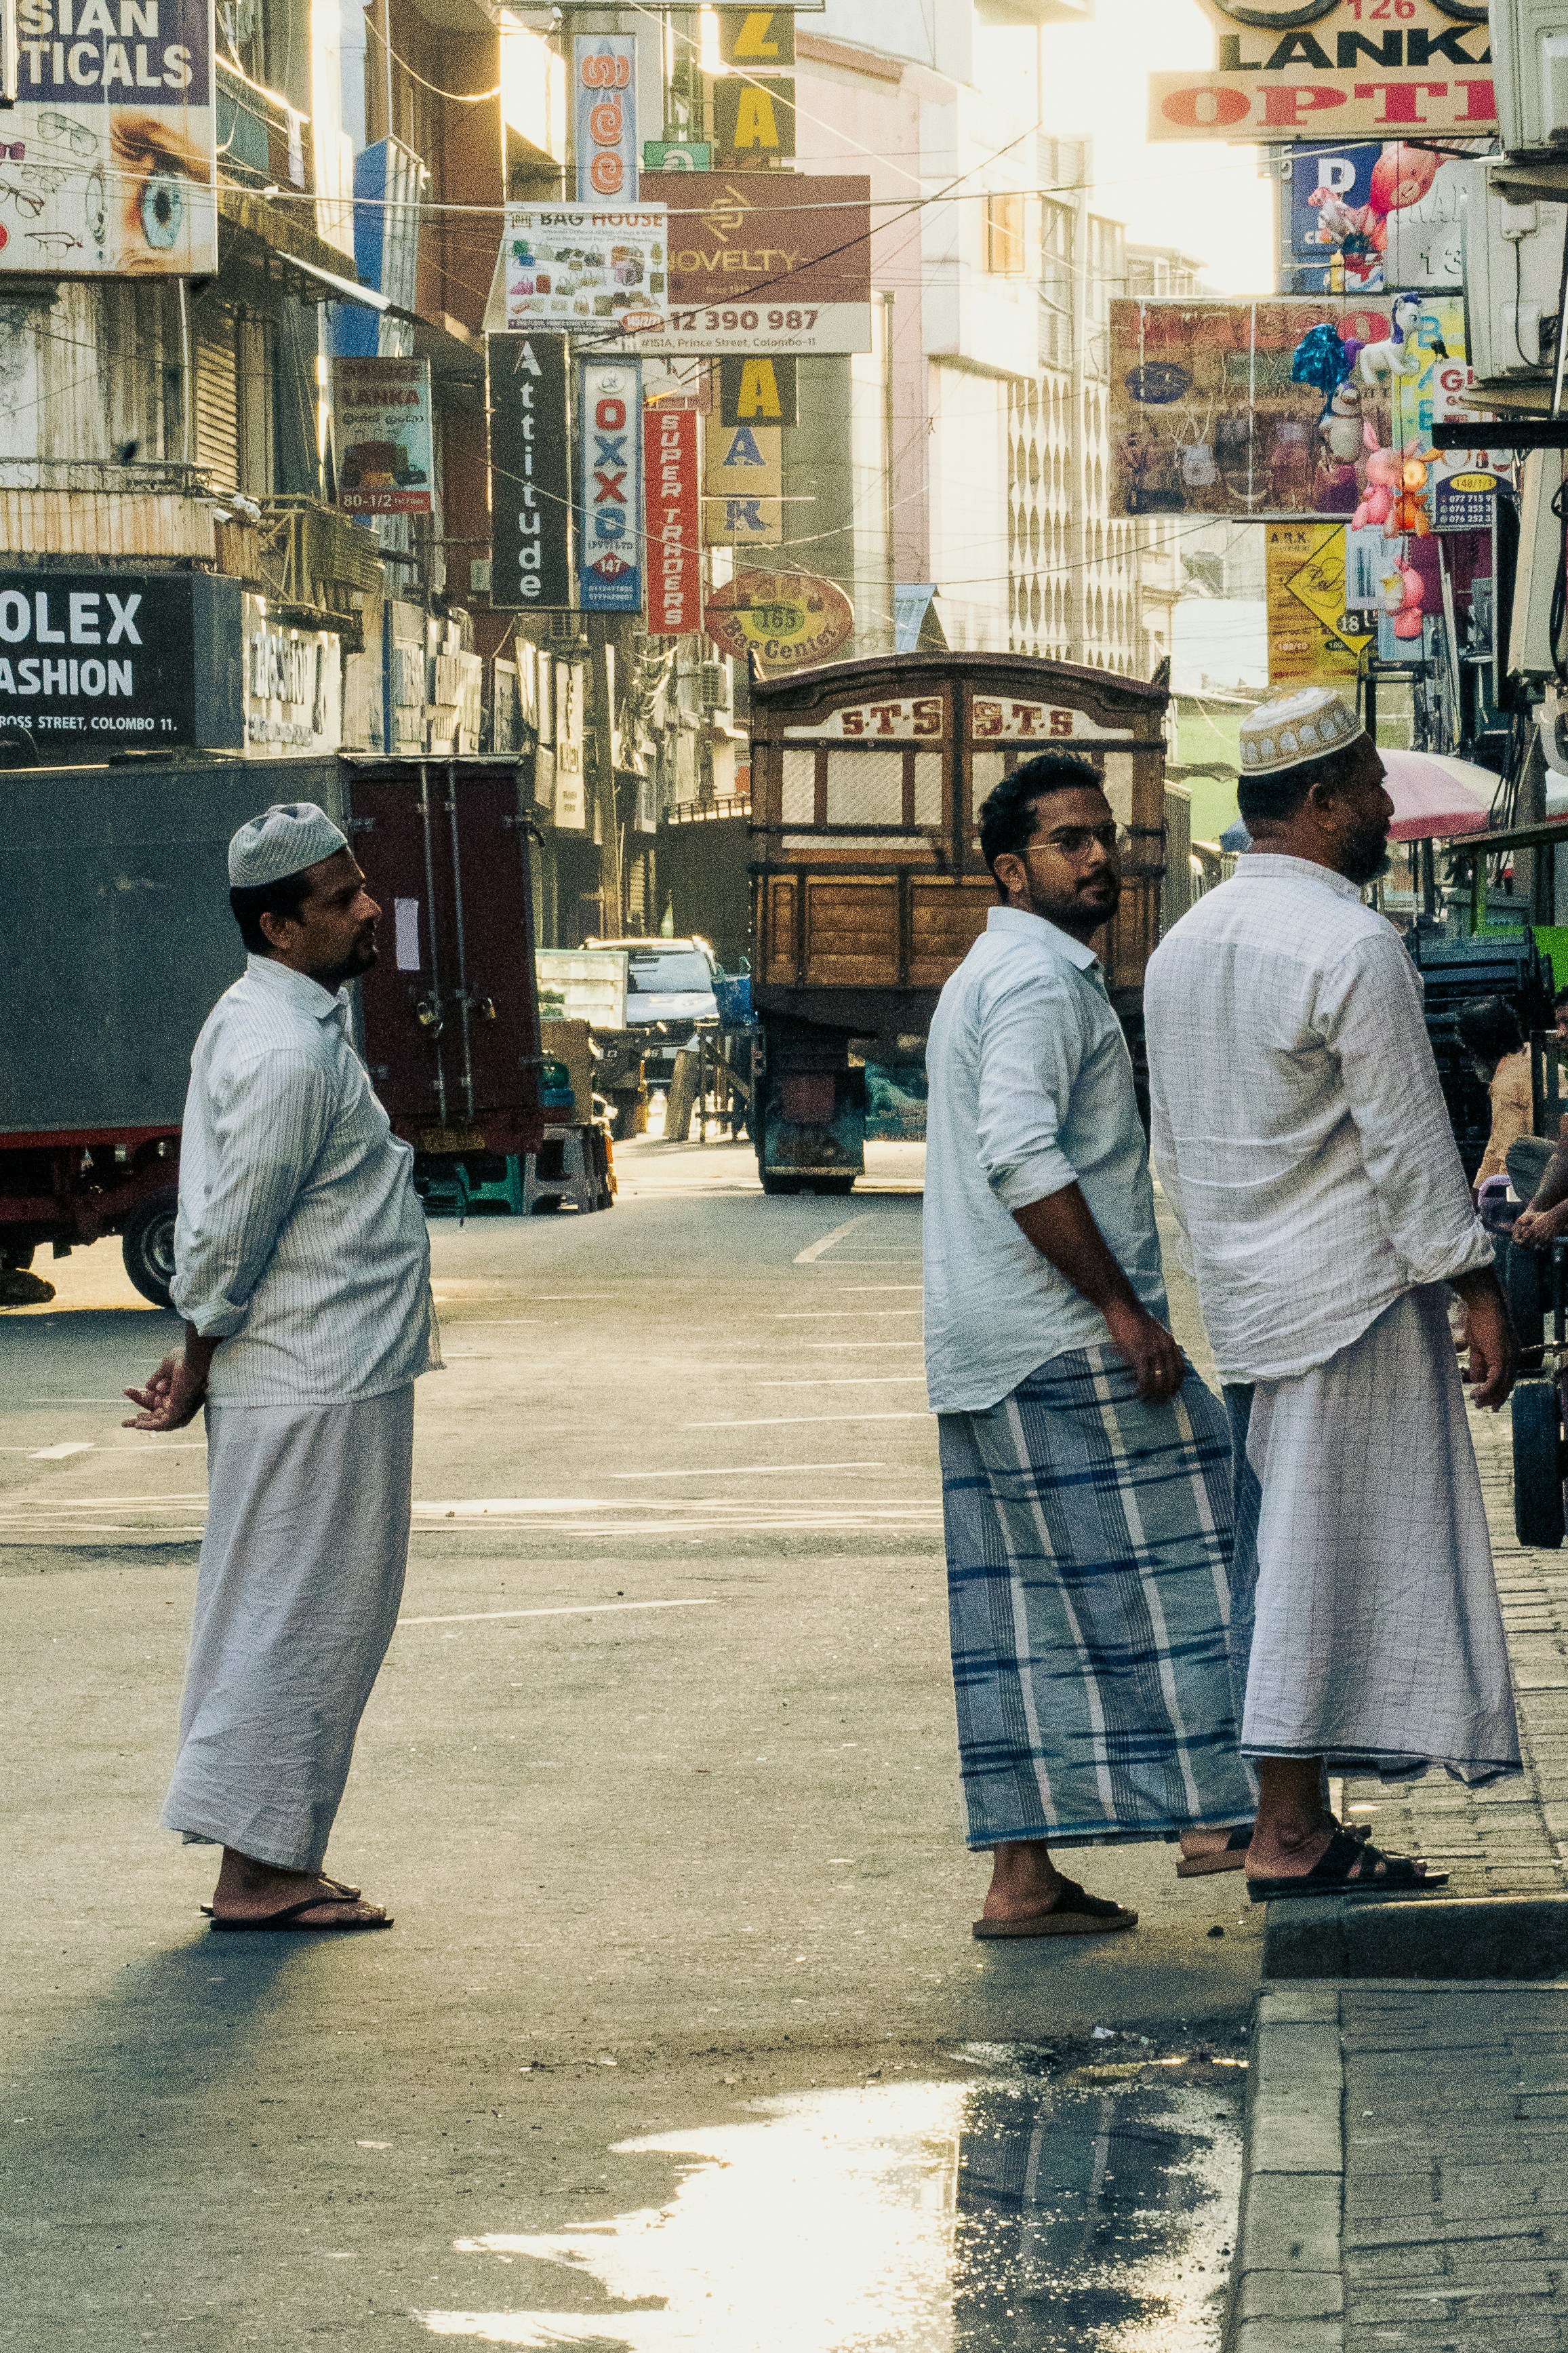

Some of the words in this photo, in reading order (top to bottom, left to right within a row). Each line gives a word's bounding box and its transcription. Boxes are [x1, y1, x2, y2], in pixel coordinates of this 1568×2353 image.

[1345, 0, 1416, 21] 126
[1220, 25, 1491, 71] LANK
[540, 212, 584, 227] BAG
[591, 212, 663, 227] HOUSE
[704, 309, 759, 332] 390
[767, 309, 819, 331] 987
[678, 337, 711, 347] Prince
[660, 414, 683, 498] SUPER
[593, 398, 628, 540] OXXO
[343, 494, 393, 508] 80-1/2
[601, 560, 622, 574] 147
[662, 507, 684, 625] TRADERS
[761, 607, 797, 629] 165
[1340, 614, 1359, 632] 18
[764, 623, 838, 659] Center
[38, 716, 87, 731] STREET,
[91, 717, 155, 730] COLOMBO
